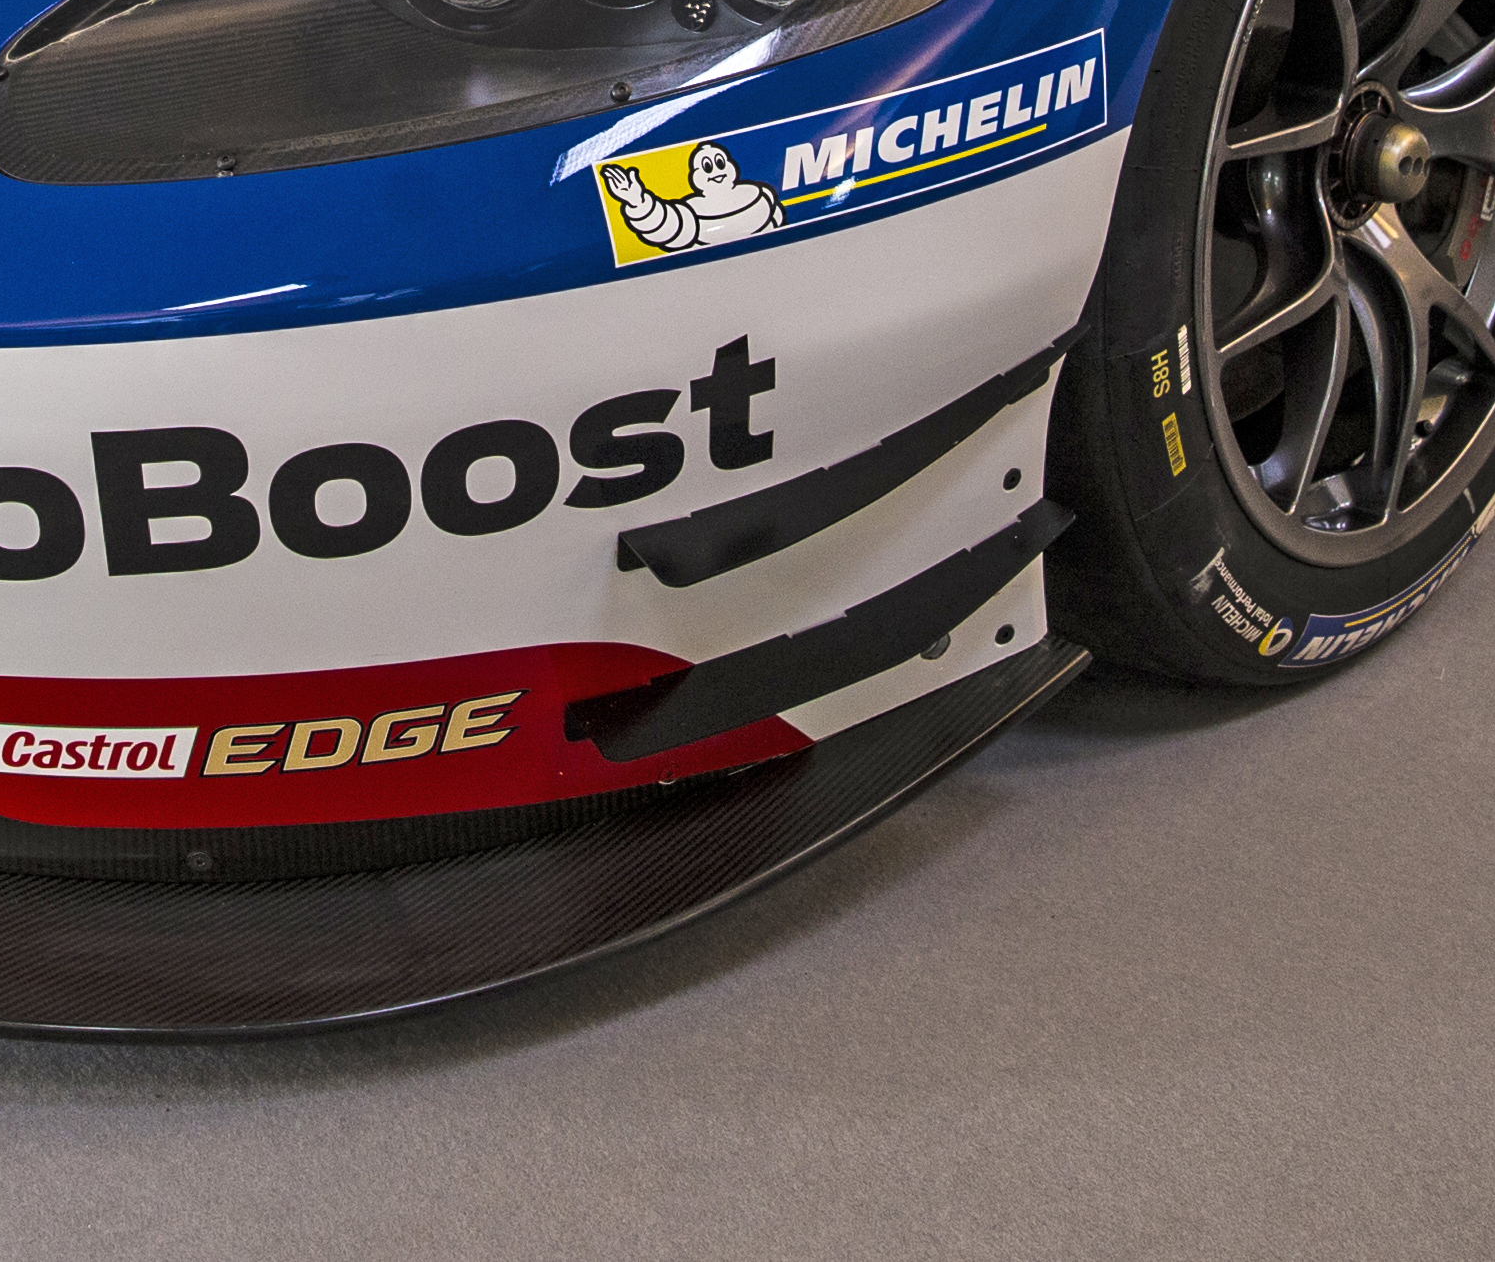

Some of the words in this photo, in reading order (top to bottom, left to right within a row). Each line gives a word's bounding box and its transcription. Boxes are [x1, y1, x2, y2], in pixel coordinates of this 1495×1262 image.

[781, 57, 1097, 191] MICHELIN
[1150, 348, 1171, 399] H8S
[1214, 556, 1257, 615] Performance
[1292, 545, 1470, 660] CHELIN
[1211, 594, 1263, 643] MICHELIN
[1251, 605, 1274, 628] Total
[1, 730, 177, 773] Castrol
[201, 689, 530, 776] EDGE
